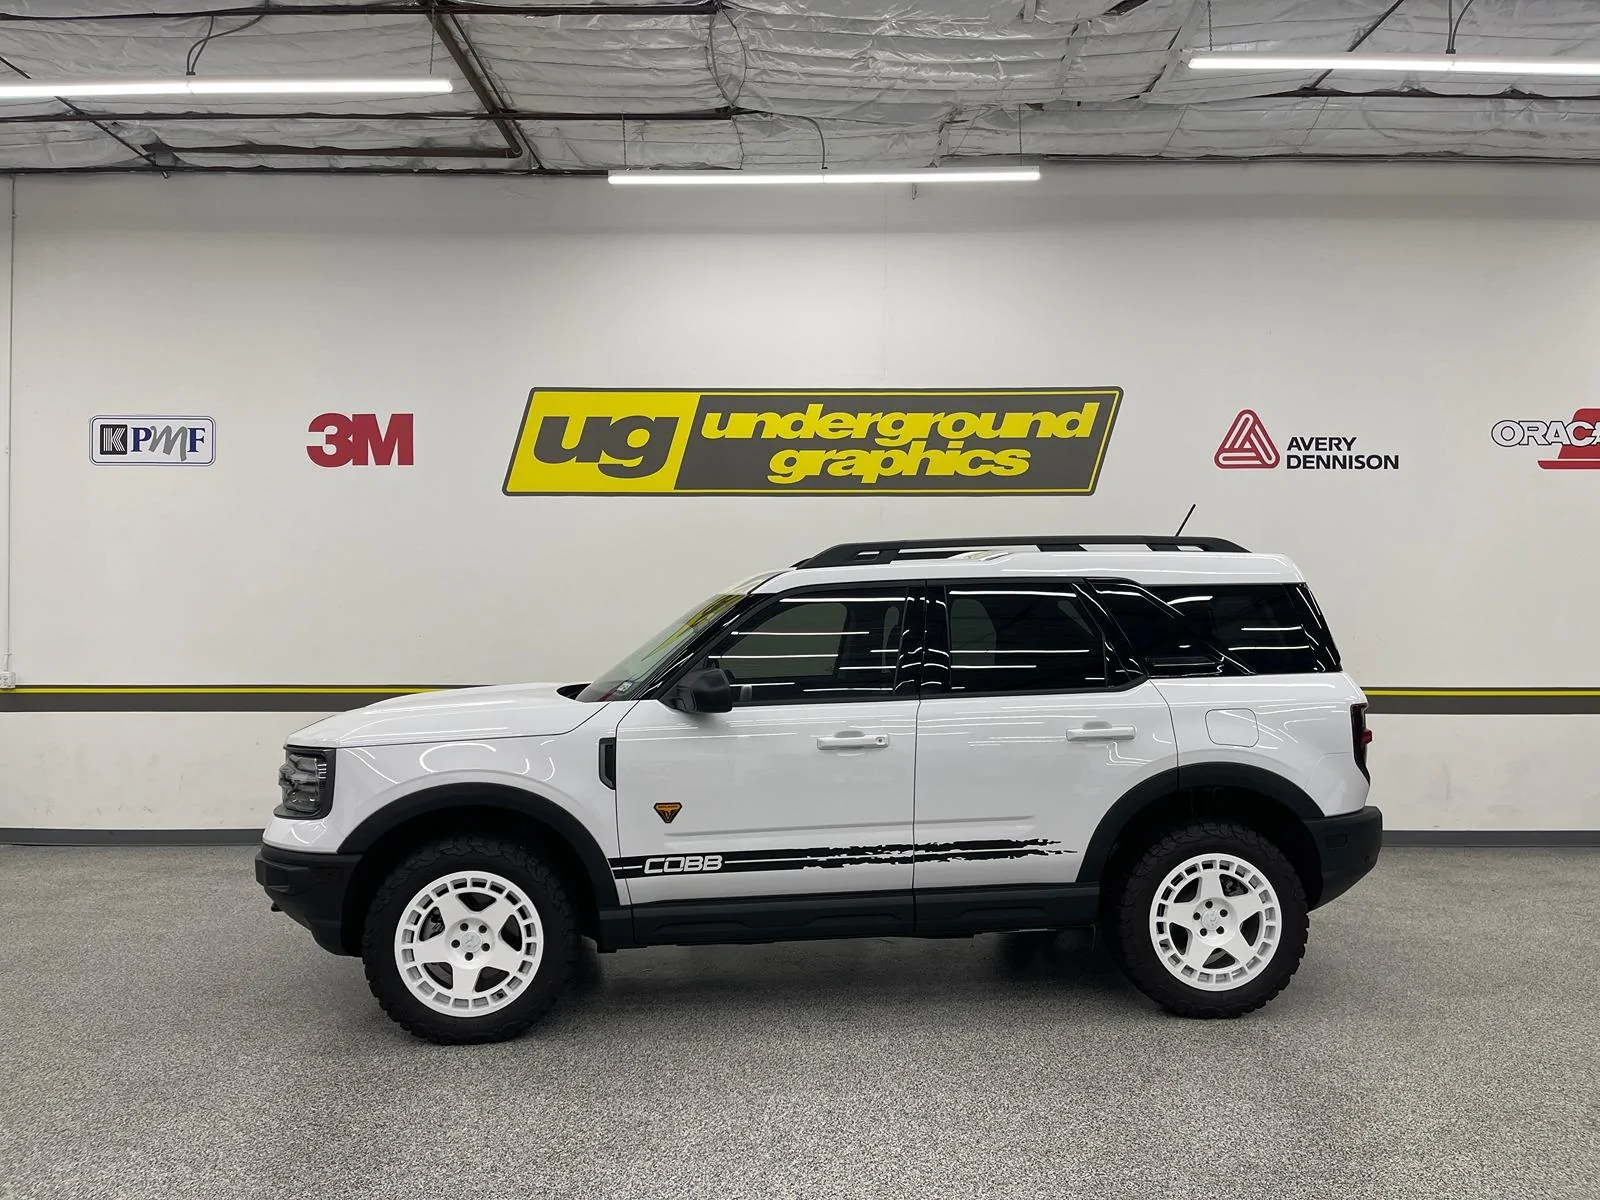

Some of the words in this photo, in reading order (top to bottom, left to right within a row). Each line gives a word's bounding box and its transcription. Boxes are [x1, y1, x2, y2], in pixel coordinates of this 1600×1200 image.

[306, 412, 414, 467] 3M
[700, 403, 1100, 447] underground
[1286, 436, 1357, 451] AVERY
[532, 415, 680, 479] ug
[768, 440, 1030, 483] graphics
[1286, 454, 1399, 470] DENNISON
[644, 855, 723, 875] COBB
